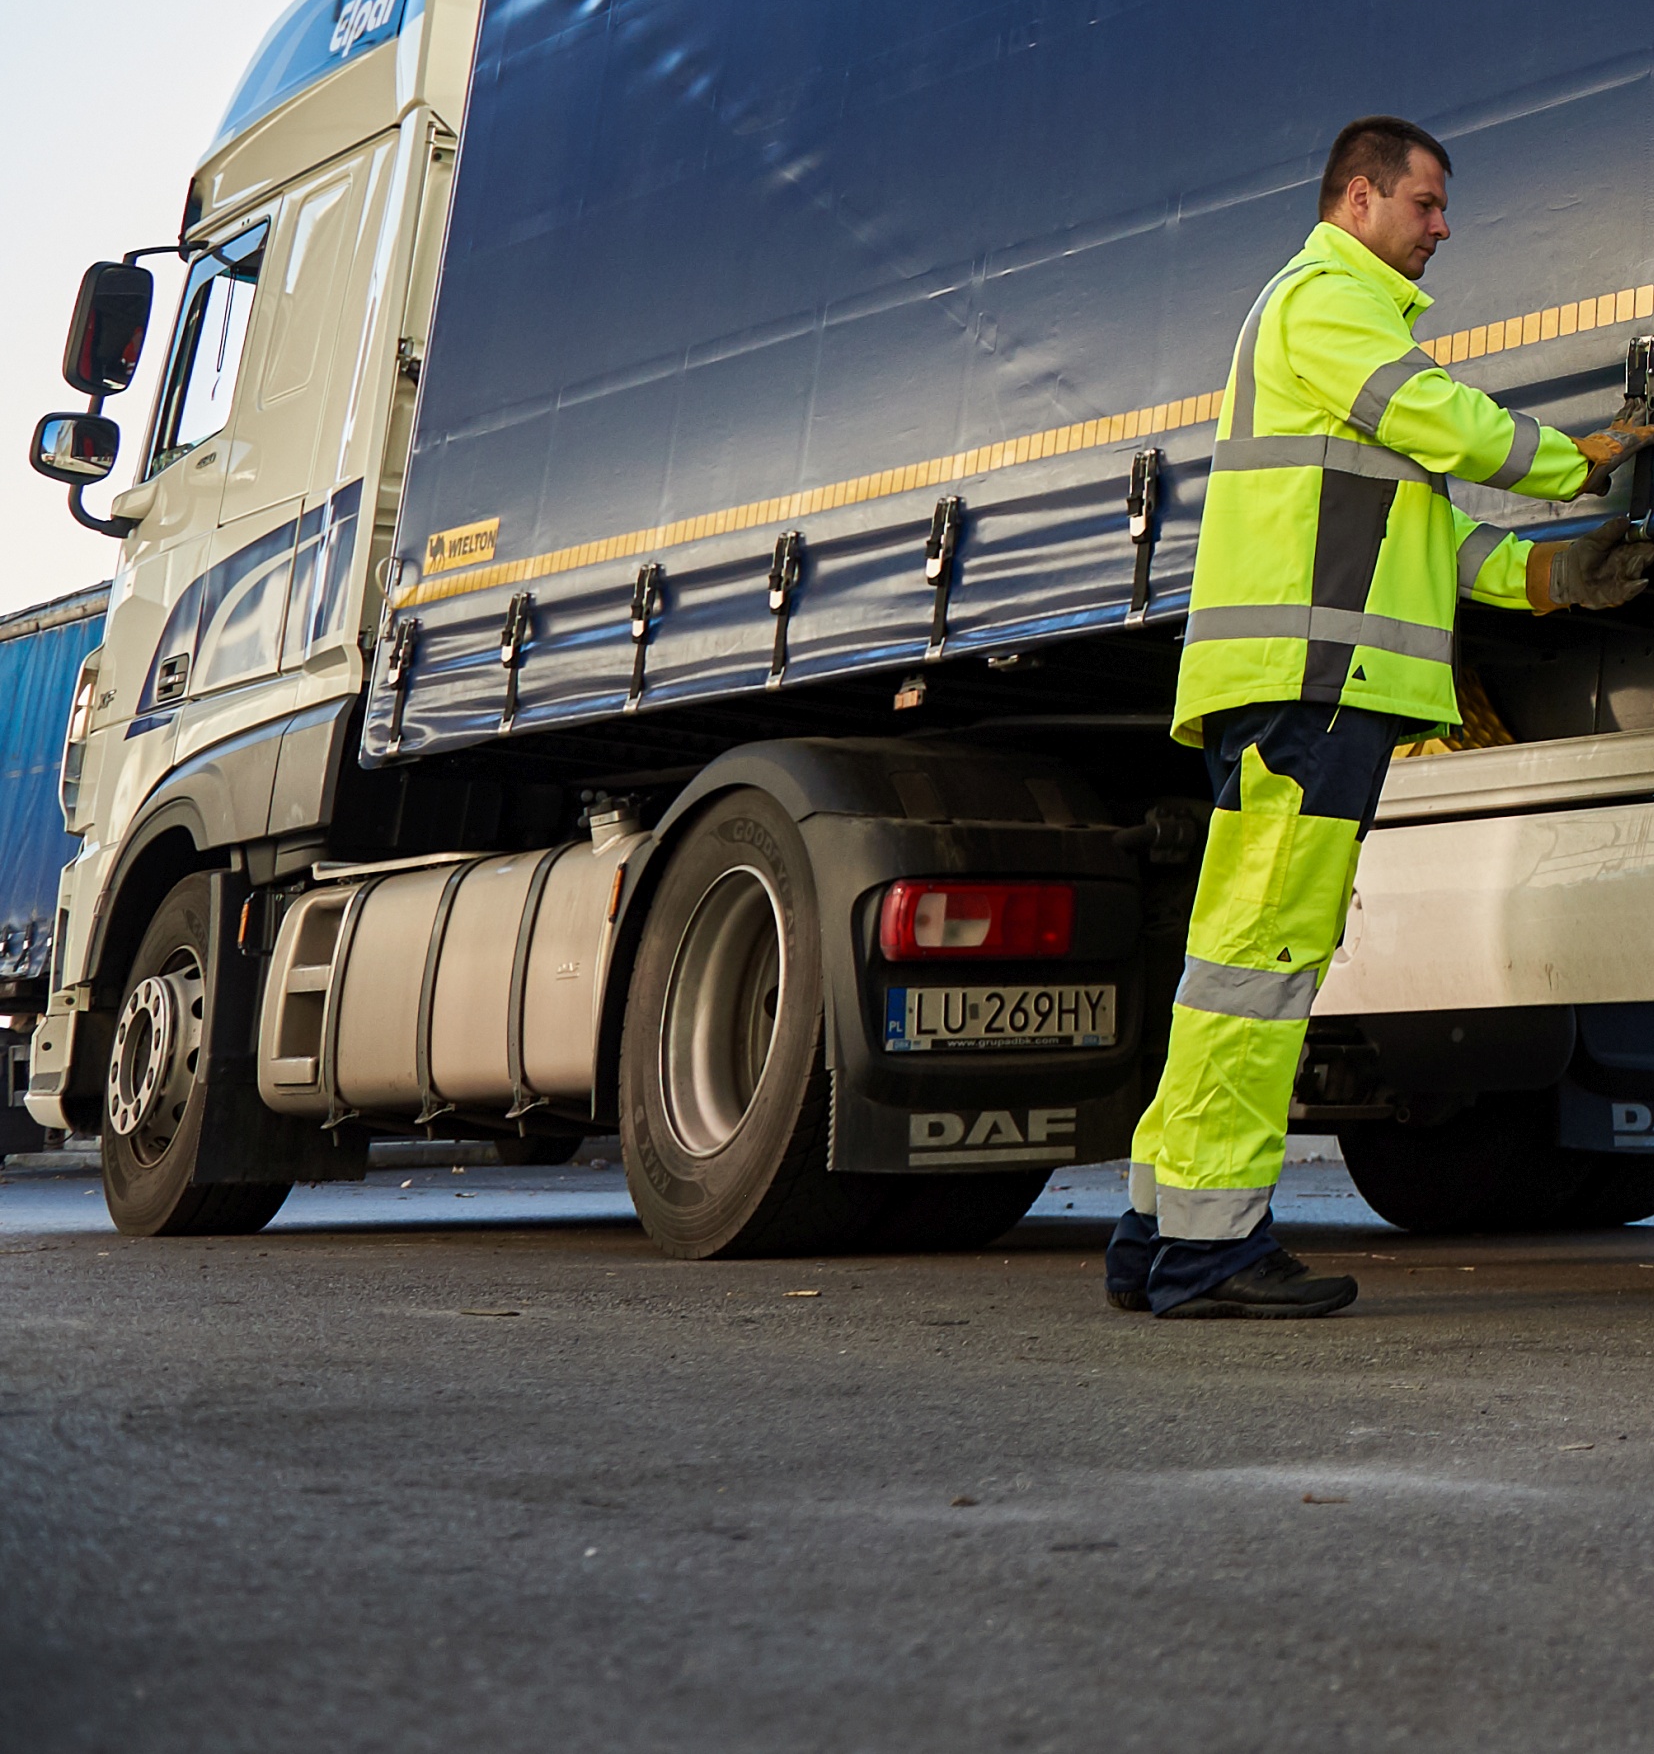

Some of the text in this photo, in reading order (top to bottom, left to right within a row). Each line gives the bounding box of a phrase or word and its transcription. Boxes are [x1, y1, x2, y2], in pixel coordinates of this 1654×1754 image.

[448, 529, 498, 558] WIELTON
[889, 1020, 904, 1033] PL
[915, 990, 1104, 1035] LU 269HY
[946, 1036, 1060, 1048] www.grupadbk.com
[909, 1107, 1076, 1148] DAF
